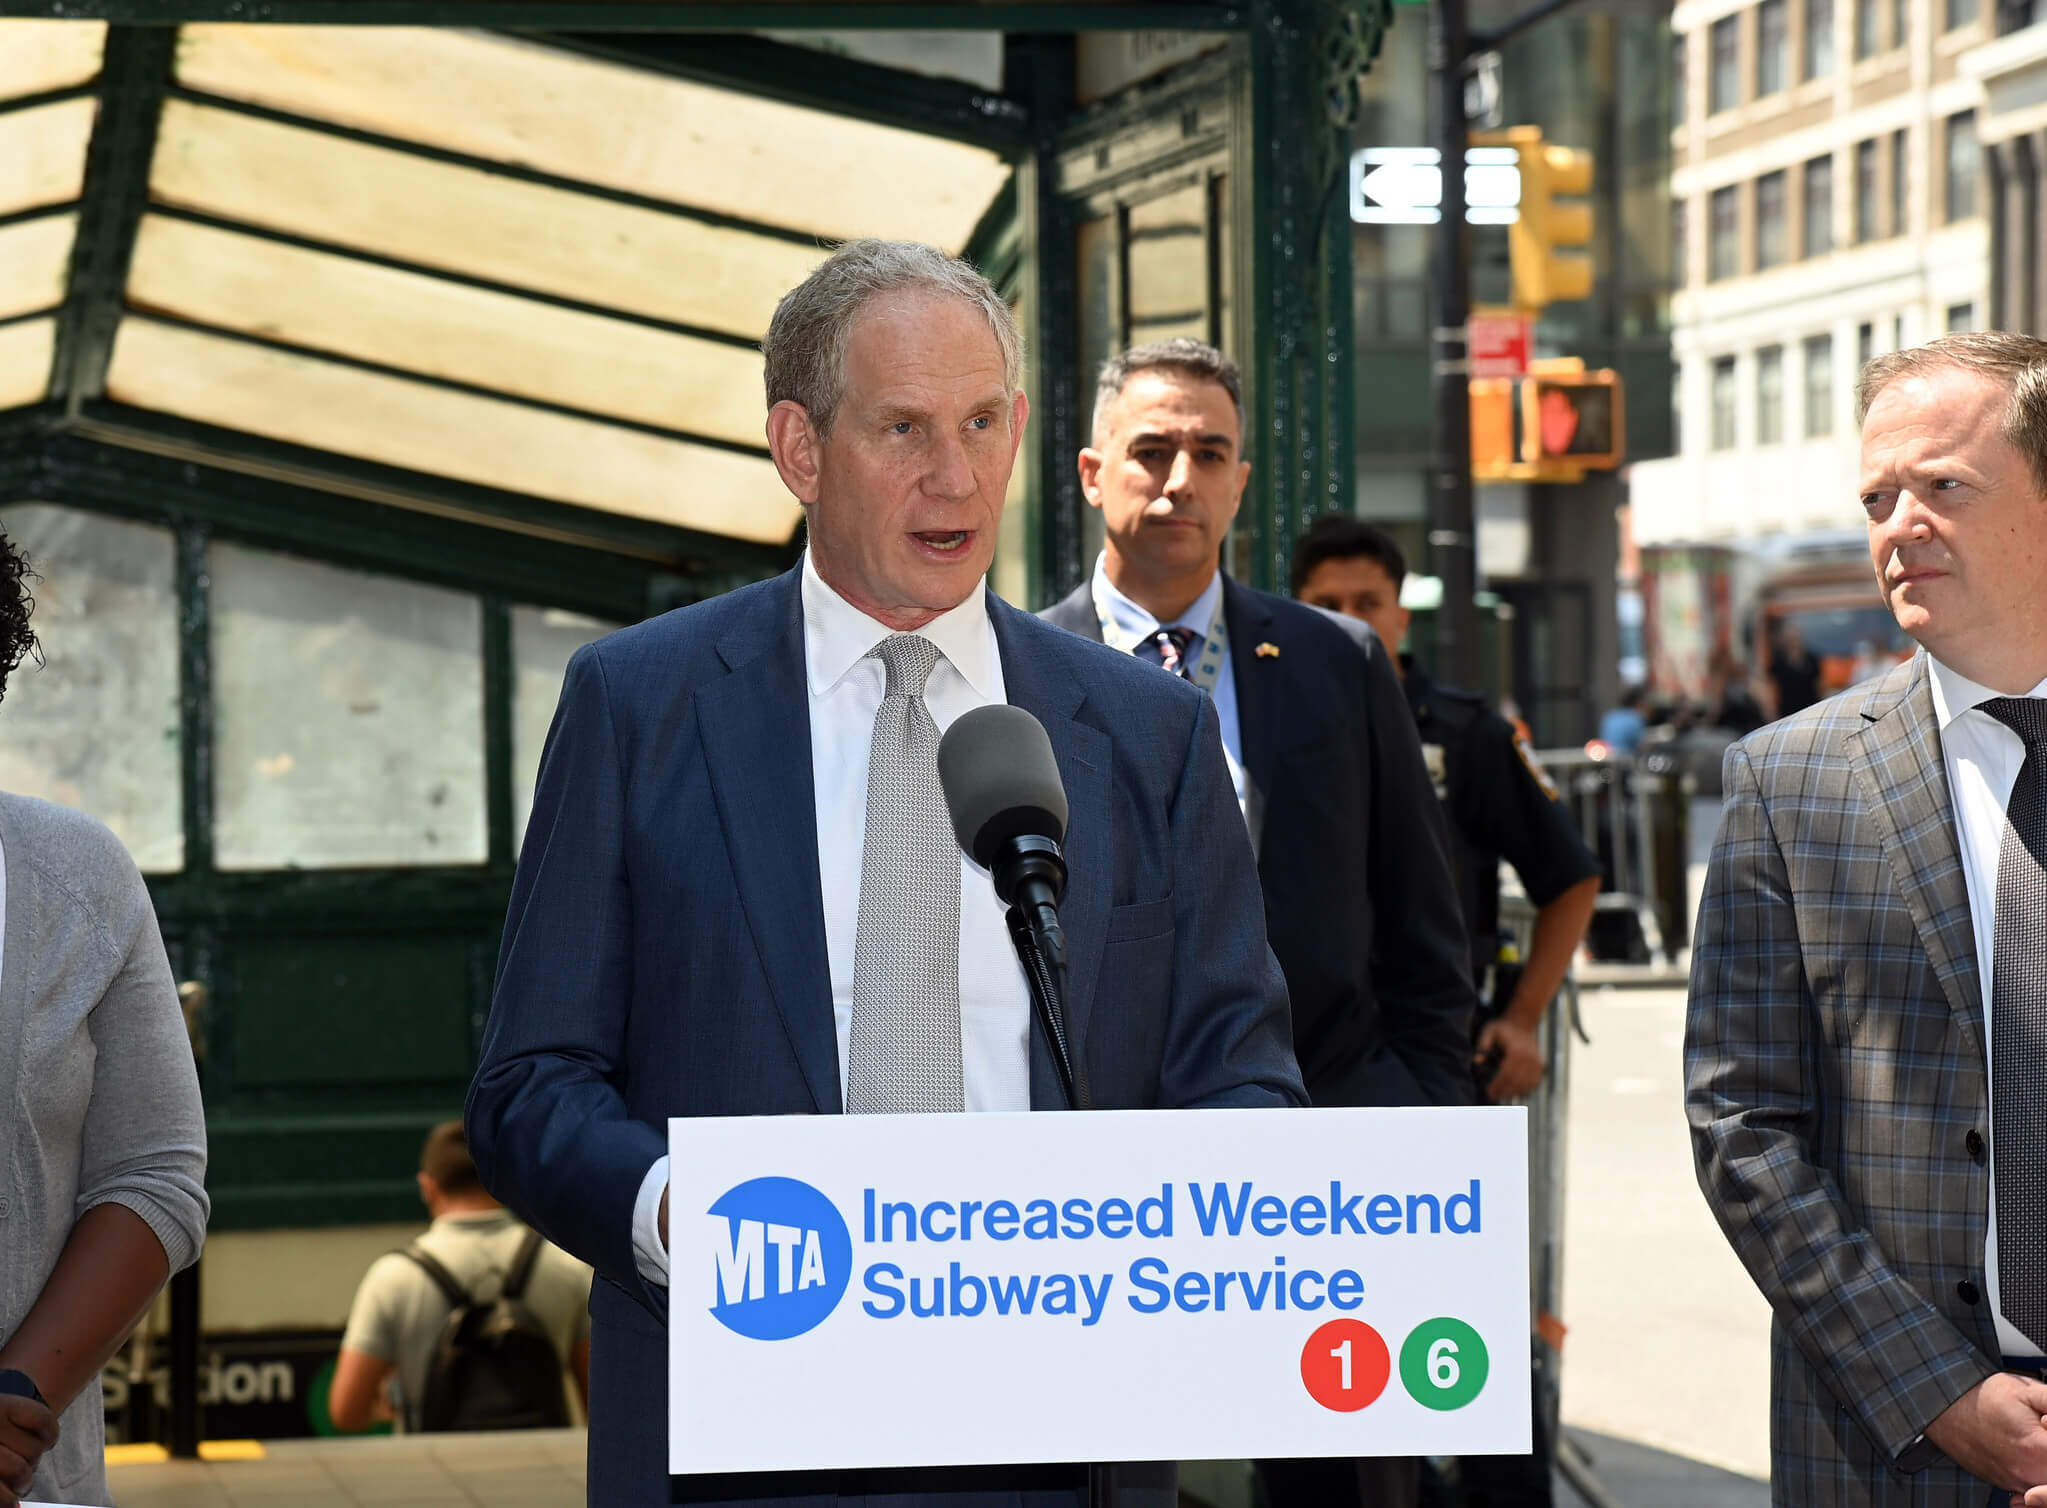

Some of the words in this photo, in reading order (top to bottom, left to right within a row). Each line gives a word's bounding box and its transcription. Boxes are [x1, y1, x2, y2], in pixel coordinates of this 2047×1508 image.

[863, 1182, 1174, 1244] Increased
[1188, 1178, 1482, 1239] Weekend
[708, 1214, 826, 1307] MTA
[861, 1261, 1115, 1327] Subway
[1127, 1255, 1366, 1314] Service
[1329, 1339, 1353, 1390] 1
[1426, 1337, 1461, 1390] 6
